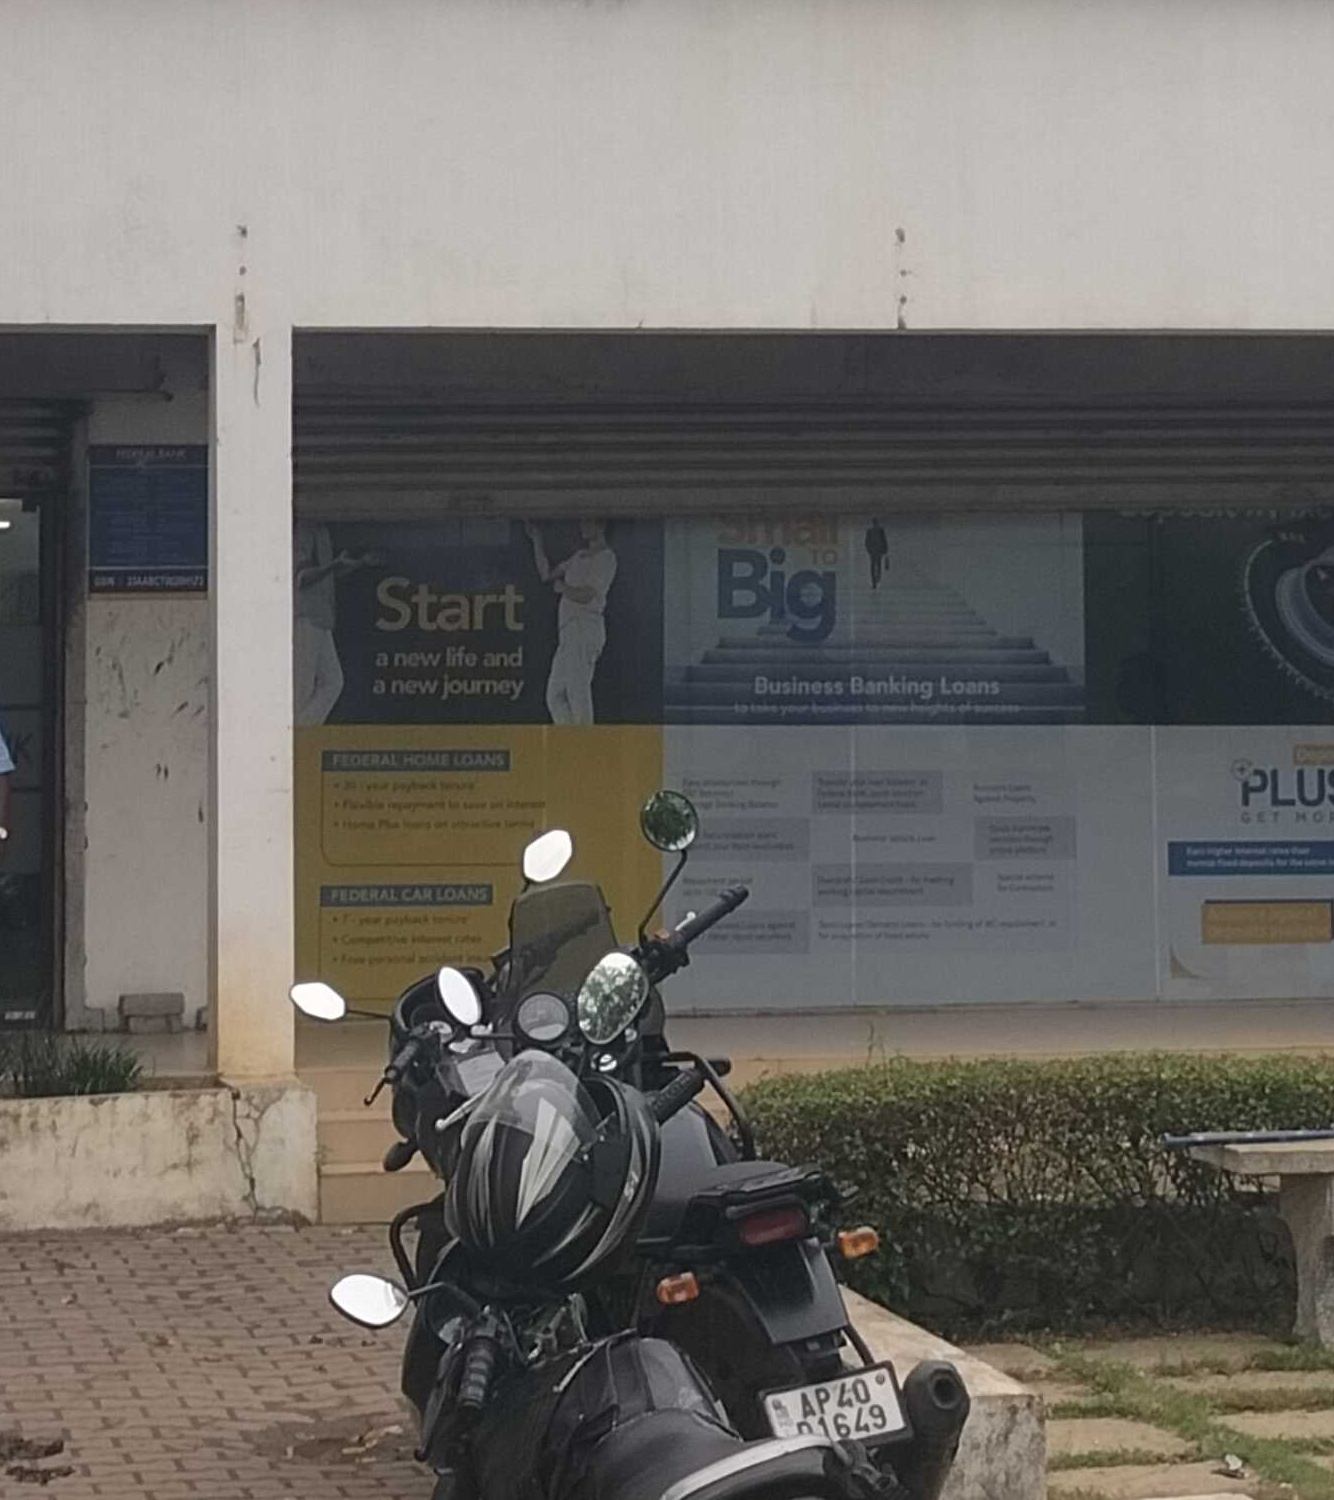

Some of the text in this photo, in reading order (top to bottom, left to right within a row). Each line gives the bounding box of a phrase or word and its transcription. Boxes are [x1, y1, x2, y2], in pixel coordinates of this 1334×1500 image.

[375, 576, 524, 631] Start
[717, 547, 836, 642] Big
[375, 645, 523, 667] a new life and
[372, 672, 524, 700] a new journey
[754, 675, 1000, 701] Business Banking Loans
[333, 753, 505, 767] FEDERAL HOME LOANS
[1241, 811, 1280, 824] GET
[331, 887, 488, 902] FEDERAL CAR LOANS
[800, 1387, 830, 1419] AP
[836, 1378, 871, 1408] 40
